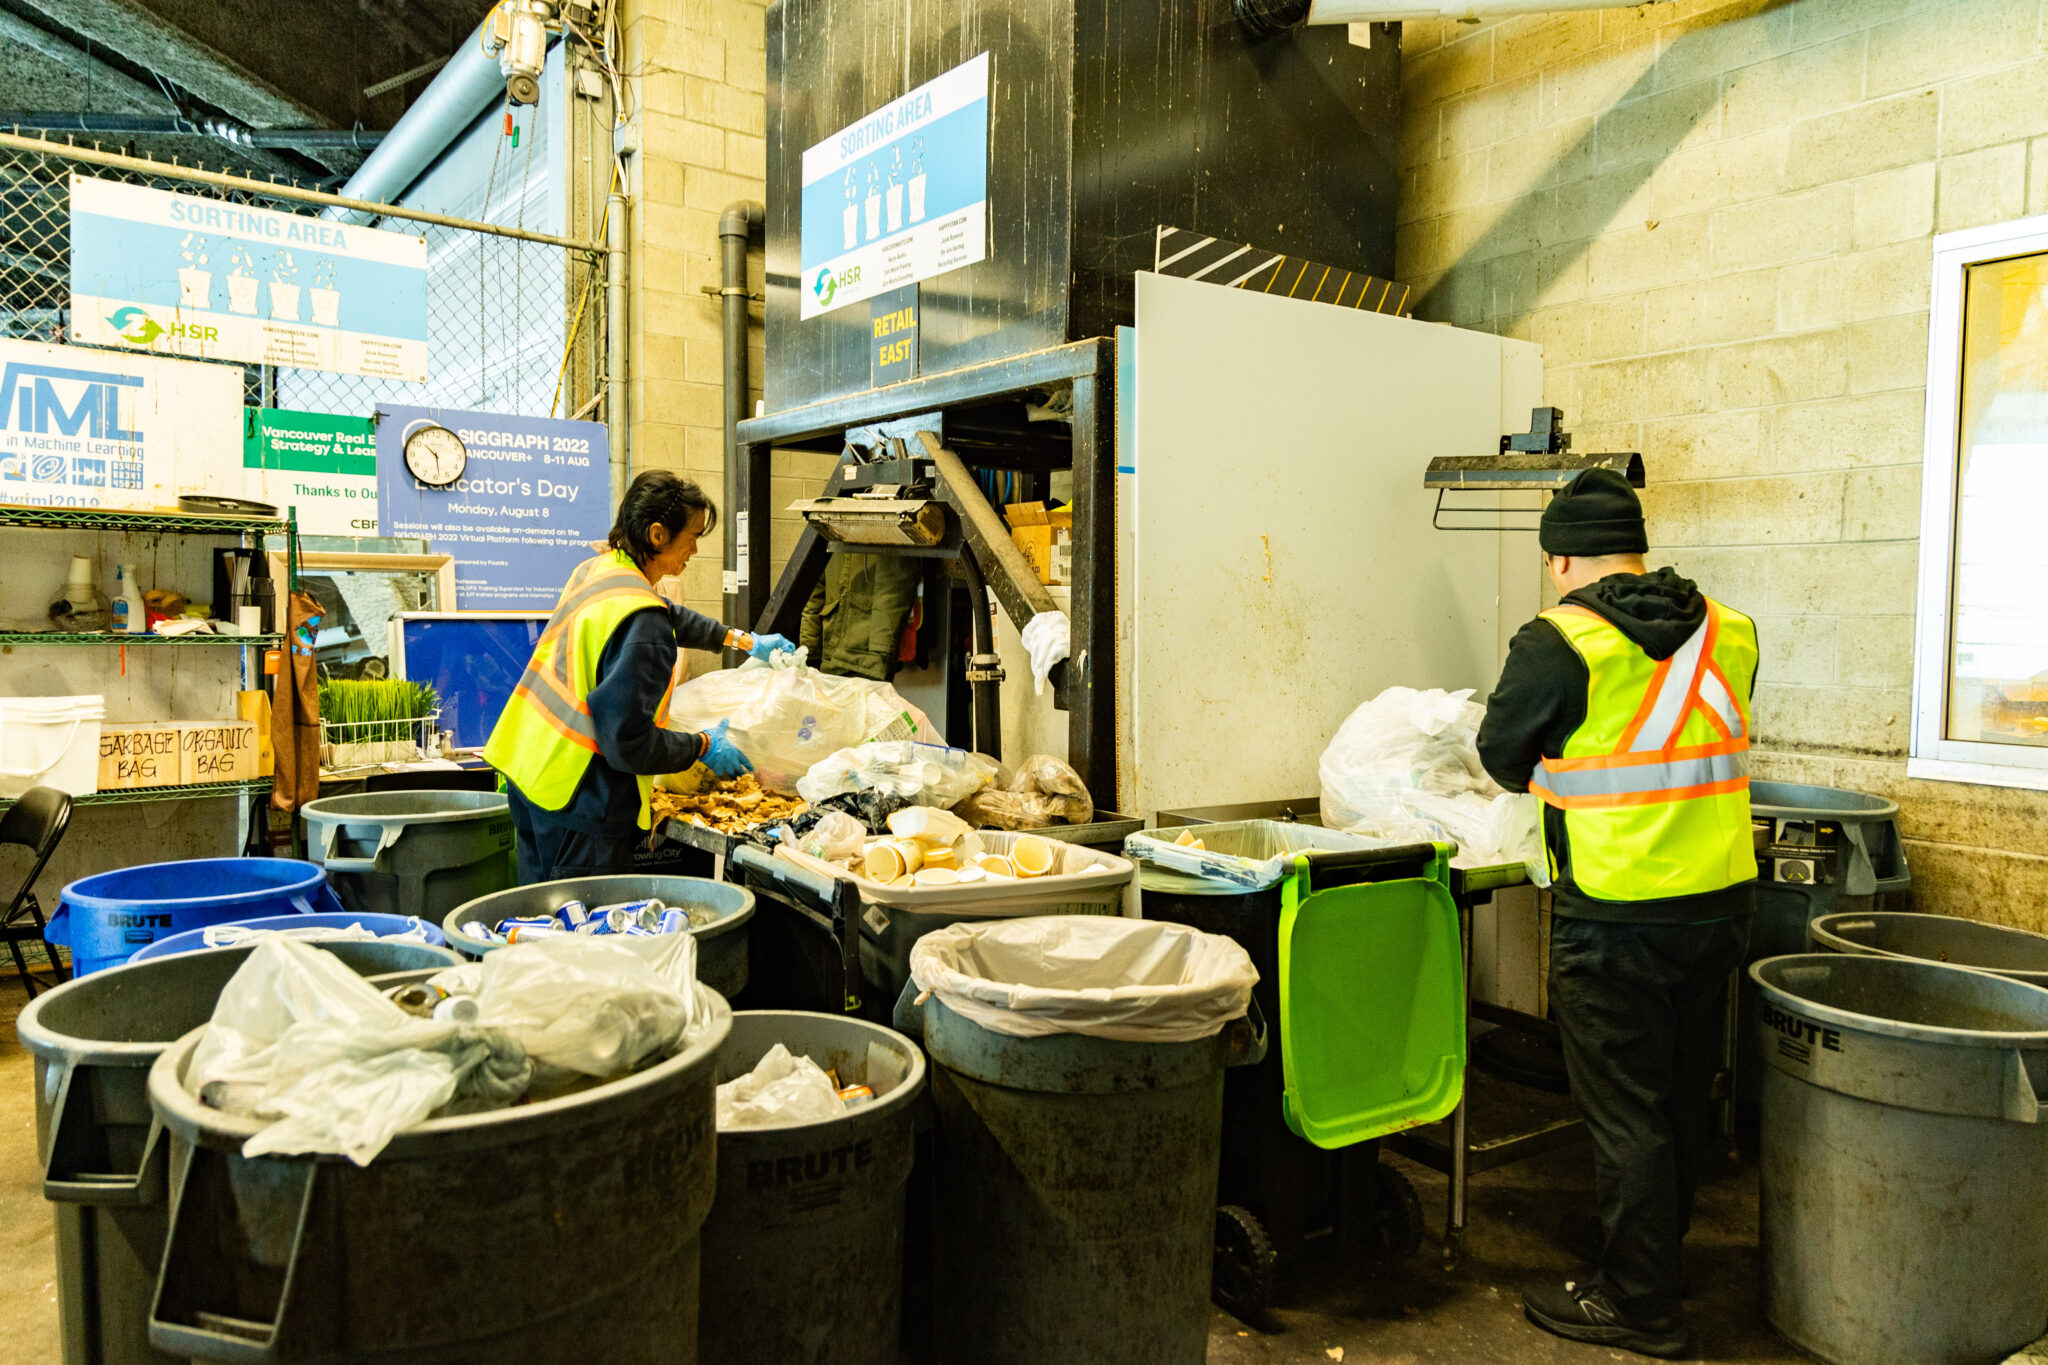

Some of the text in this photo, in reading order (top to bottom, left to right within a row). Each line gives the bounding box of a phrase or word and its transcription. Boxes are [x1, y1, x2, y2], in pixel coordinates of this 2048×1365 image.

[840, 90, 932, 159] SORTING AREA
[169, 199, 347, 250] SORTING AREA
[839, 266, 861, 288] HSR
[170, 322, 218, 342] HSR
[874, 306, 917, 338] RETAIL
[880, 338, 911, 367] EAST
[262, 425, 334, 442] Vancouver
[335, 431, 365, 444] Real
[457, 429, 590, 454] SIGGRAPH 2022
[6, 435, 144, 461] in Machine Learning
[270, 438, 331, 456] Strategy
[333, 443, 344, 454] &
[465, 448, 590, 467] ANCOUVER+ 8-11 AUG
[293, 483, 340, 498] Thanks
[344, 486, 357, 498] to
[537, 479, 579, 502] Day
[448, 502, 550, 518] Monday, August 8
[393, 520, 428, 530] Sessions
[431, 522, 443, 531] will
[444, 523, 461, 532] also
[462, 524, 474, 532] be
[475, 525, 510, 534] available
[512, 527, 555, 536] on-demand
[567, 528, 580, 537] the
[438, 533, 457, 541] 2022
[460, 534, 485, 542] Virtual
[486, 535, 520, 544] Platform
[521, 536, 554, 546] following
[555, 537, 568, 546] the
[100, 732, 174, 757] GARBAGE
[182, 727, 253, 753] ORGANIC
[117, 758, 156, 780] BAG
[197, 753, 235, 774] BAG
[108, 914, 172, 928] BRUTE
[1764, 1004, 1841, 1053] BRUTE
[747, 1138, 873, 1189] BRUTE
